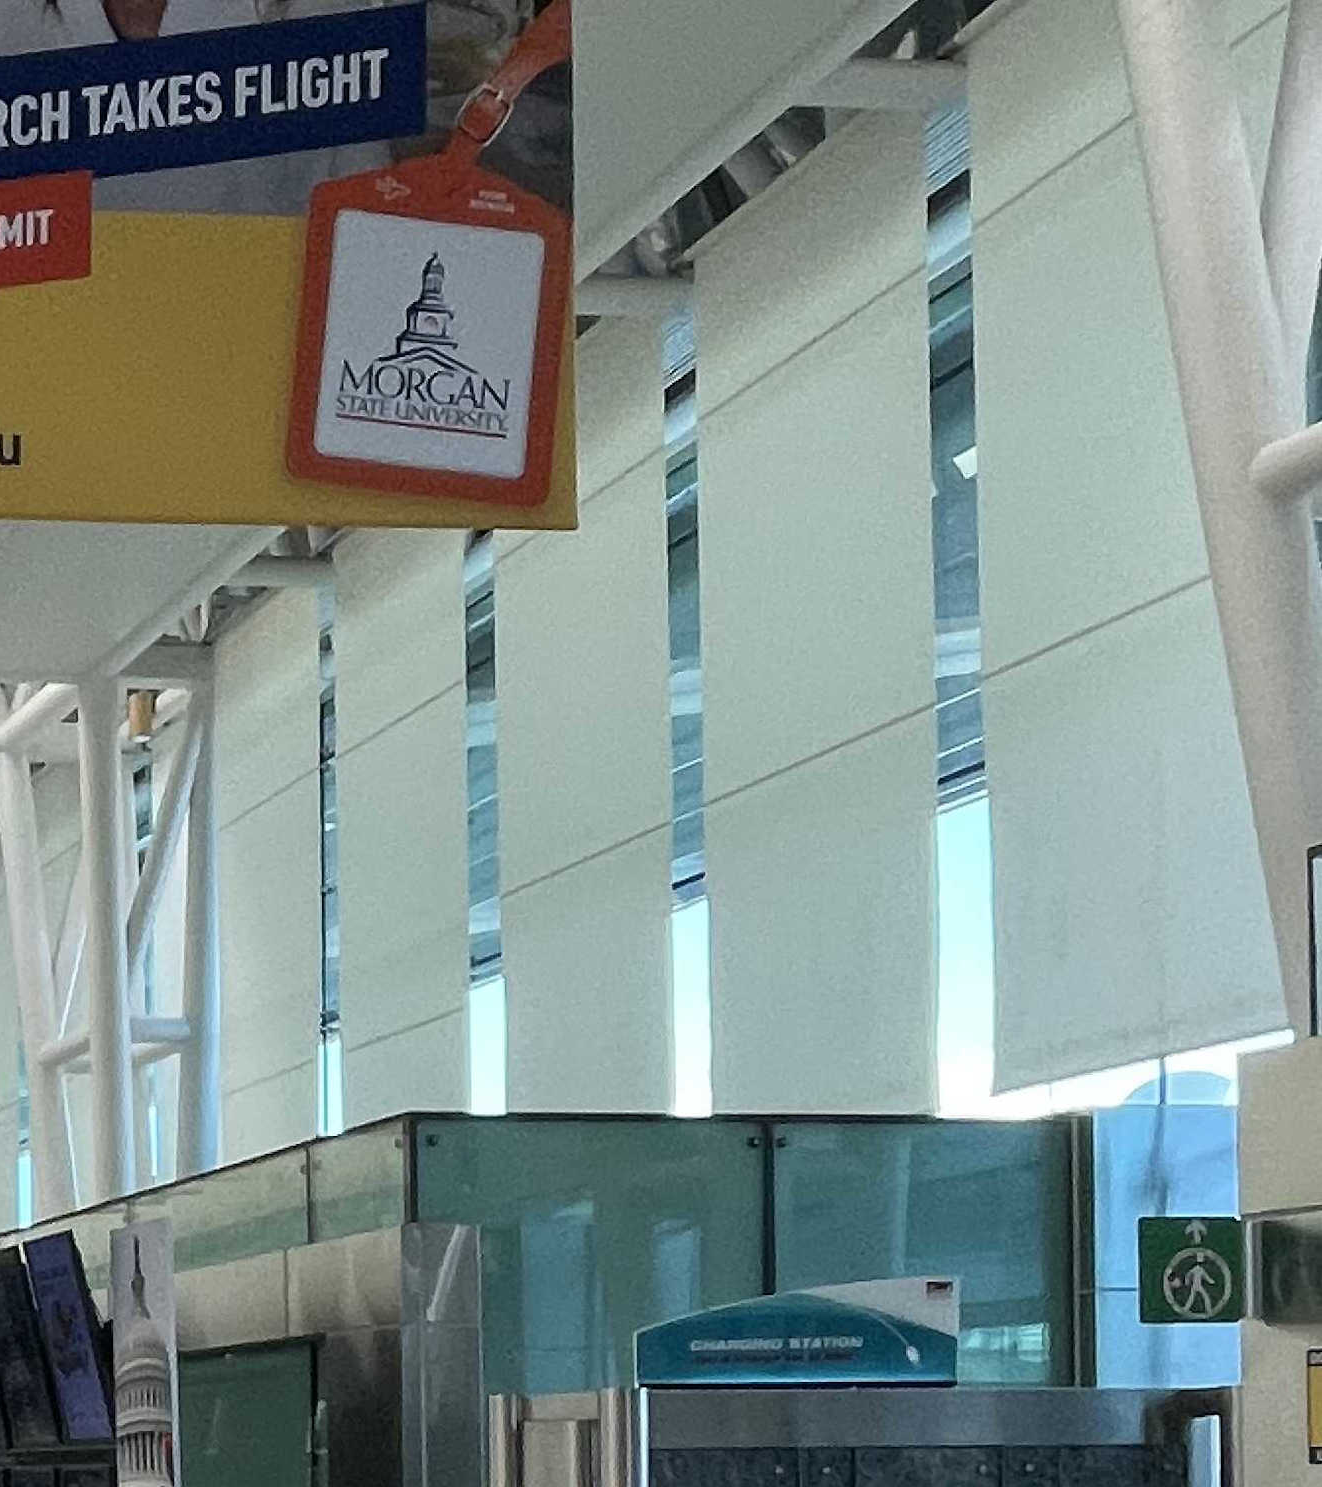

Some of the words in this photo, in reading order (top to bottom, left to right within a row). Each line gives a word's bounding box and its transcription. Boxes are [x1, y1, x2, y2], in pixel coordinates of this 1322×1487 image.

[82, 71, 223, 137] TAKES
[234, 48, 390, 118] FLIGHT
[337, 359, 511, 411] MORGAN
[336, 395, 389, 418] STATE
[394, 401, 509, 432] UNIVERSITY
